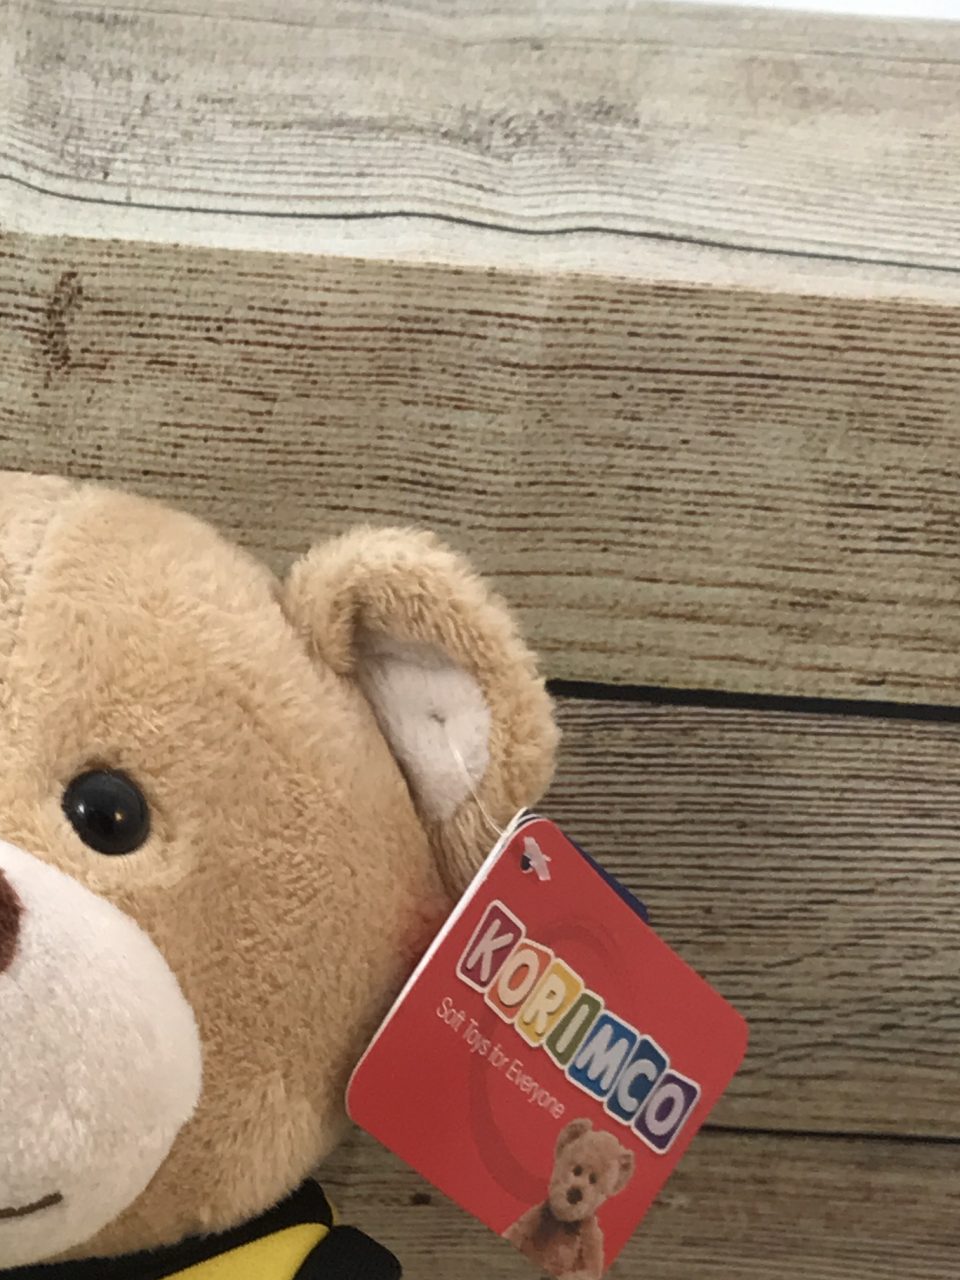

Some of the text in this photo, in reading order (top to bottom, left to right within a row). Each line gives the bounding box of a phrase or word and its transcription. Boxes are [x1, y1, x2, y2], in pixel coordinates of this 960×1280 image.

[436, 996, 566, 1120] Soft Toys for Everyone
[465, 918, 686, 1137] KORIMCO
